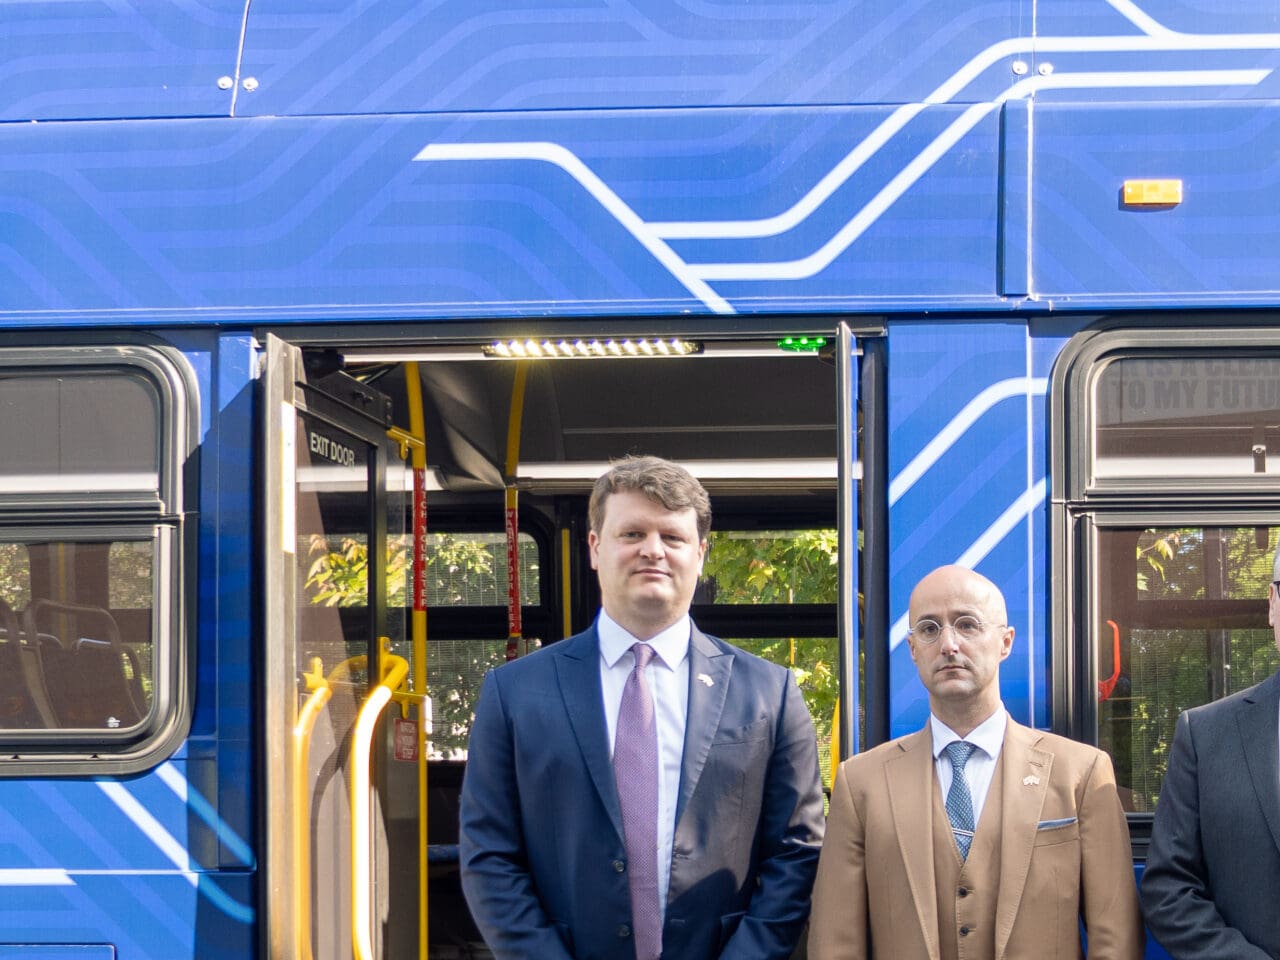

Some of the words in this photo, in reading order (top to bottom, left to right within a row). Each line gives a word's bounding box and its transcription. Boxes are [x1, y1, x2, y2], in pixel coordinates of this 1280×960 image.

[1111, 379, 1146, 408] TO
[1154, 379, 1199, 408] MY
[311, 431, 329, 457] EXIT
[331, 441, 355, 469] DOOR
